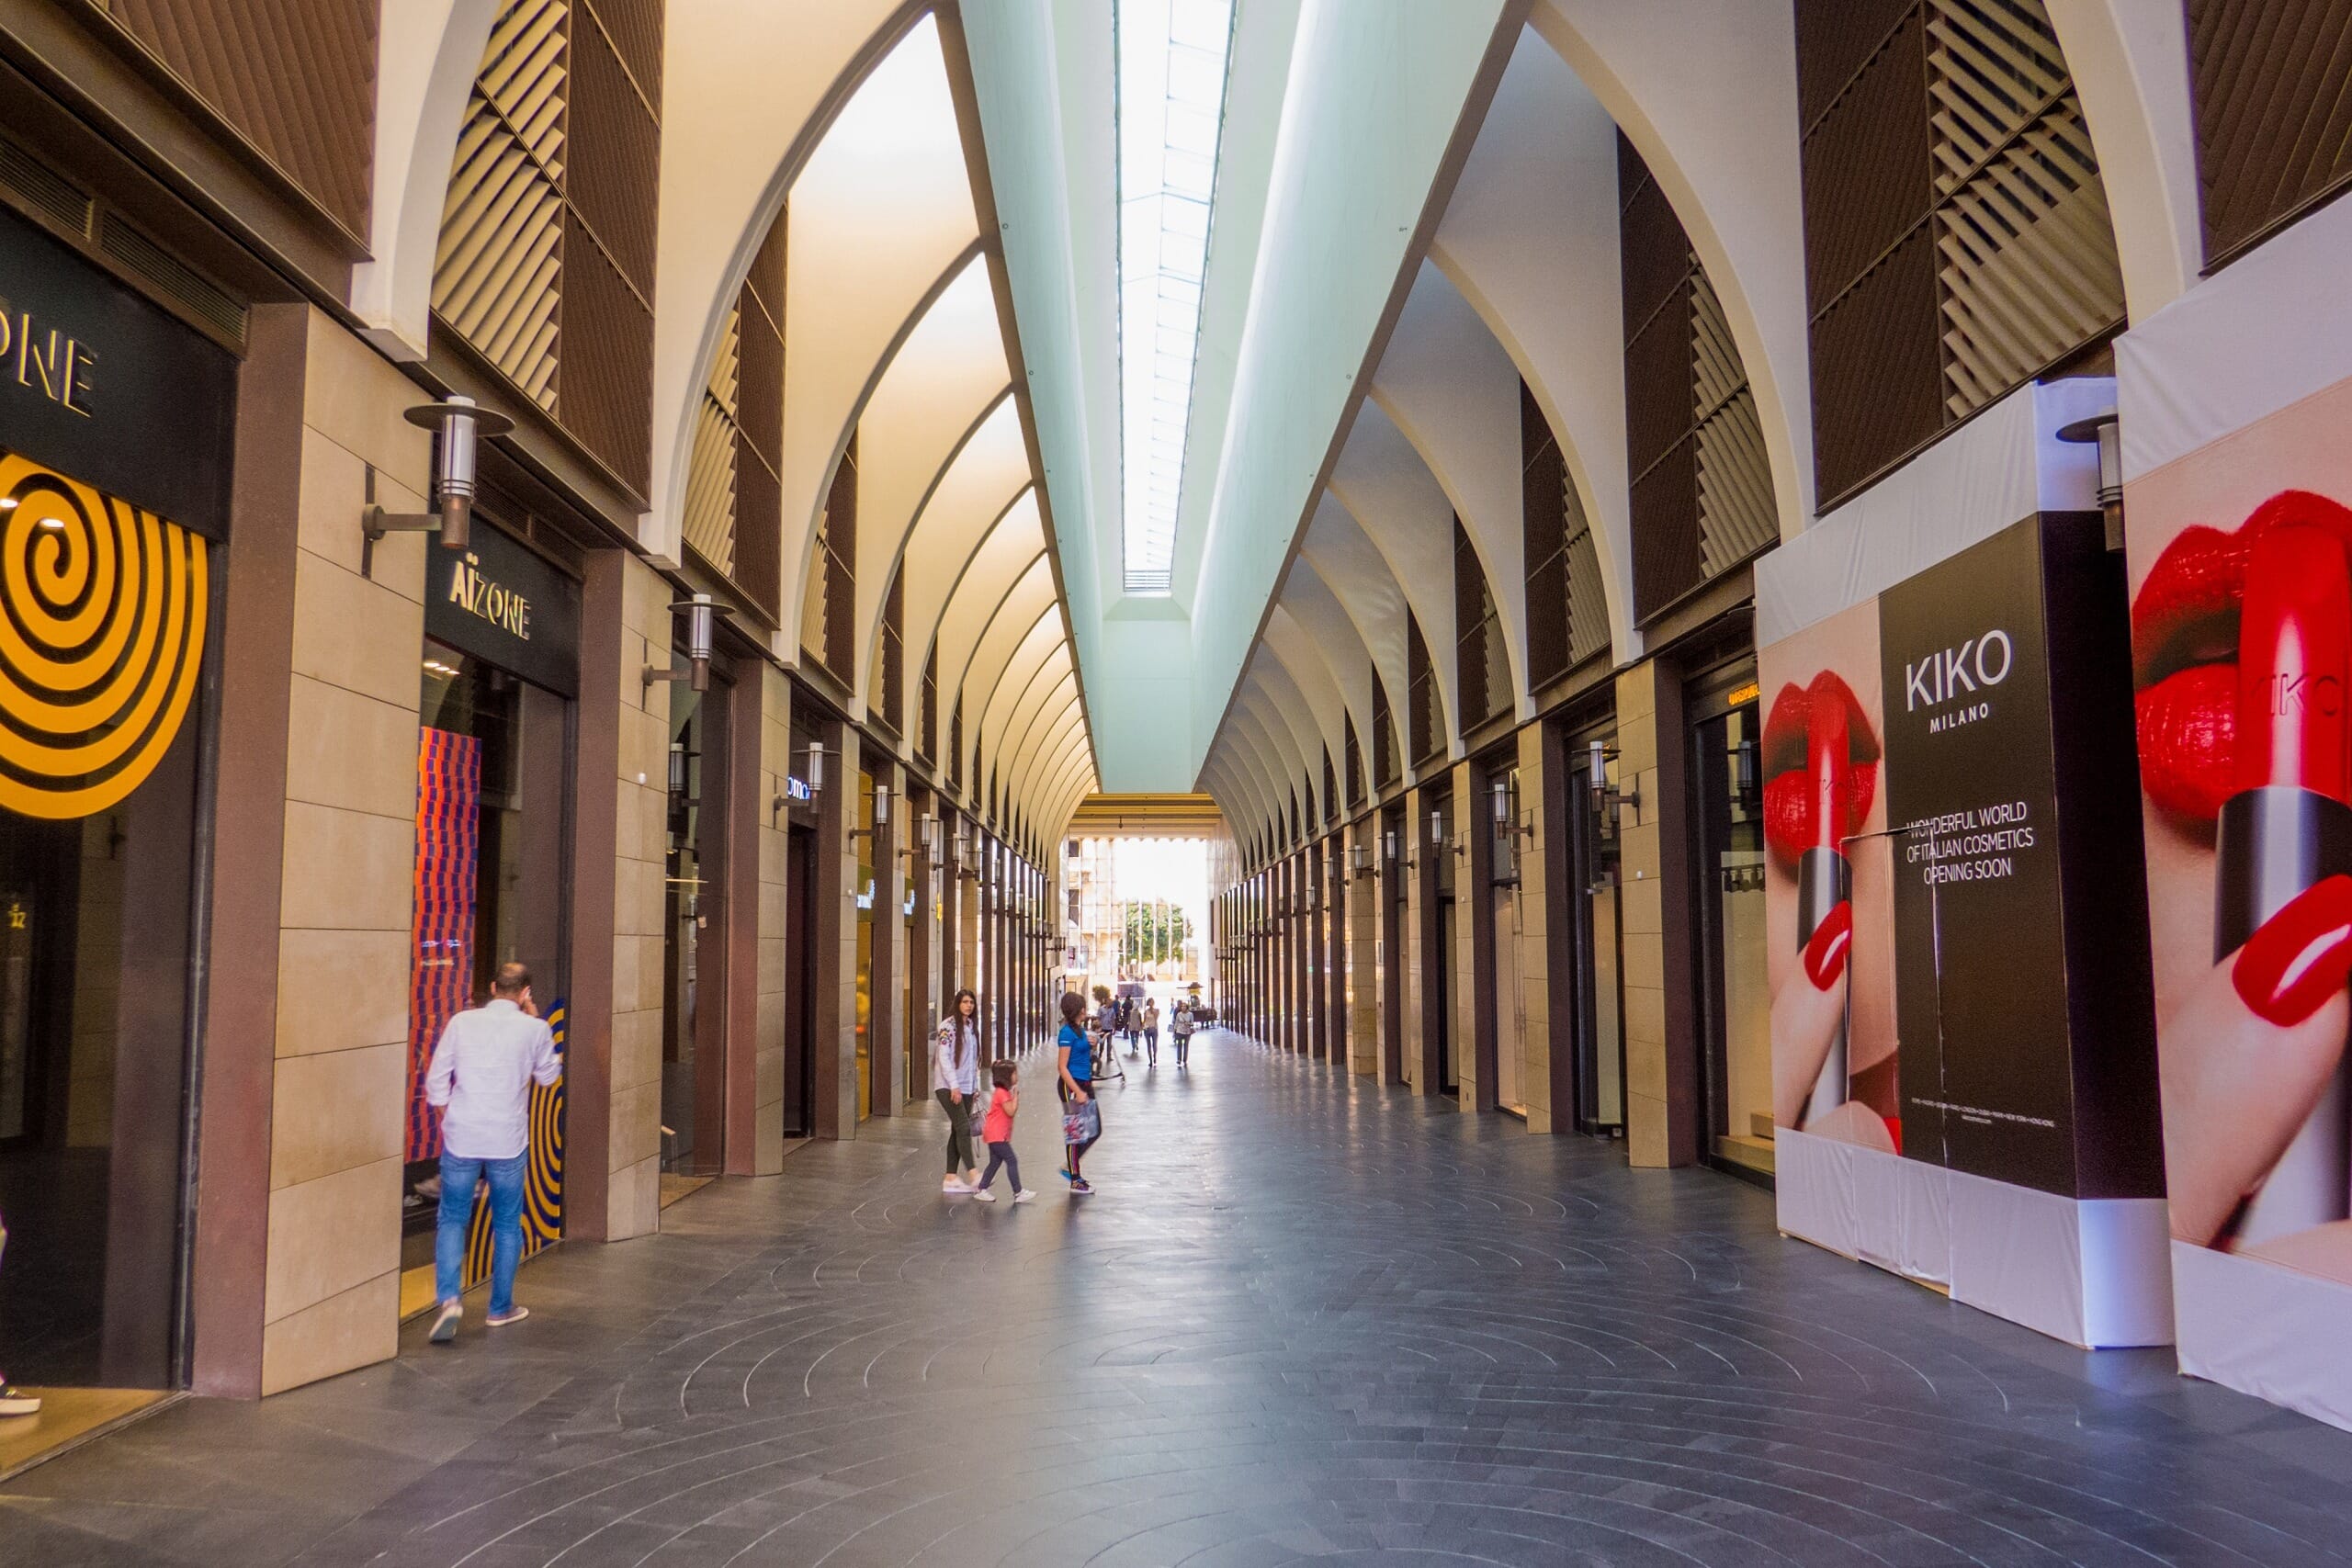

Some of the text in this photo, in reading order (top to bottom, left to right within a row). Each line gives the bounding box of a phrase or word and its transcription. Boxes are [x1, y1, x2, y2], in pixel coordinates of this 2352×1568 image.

[0, 305, 95, 419] NE
[1906, 630, 2011, 712] KIKO
[1930, 703, 1988, 734] MILANO
[1906, 802, 2027, 839] WONDERFUL WORLD
[1906, 828, 2034, 863] OF ITALIAN COSMETICS
[1924, 857, 2012, 885] OPENING SOON
